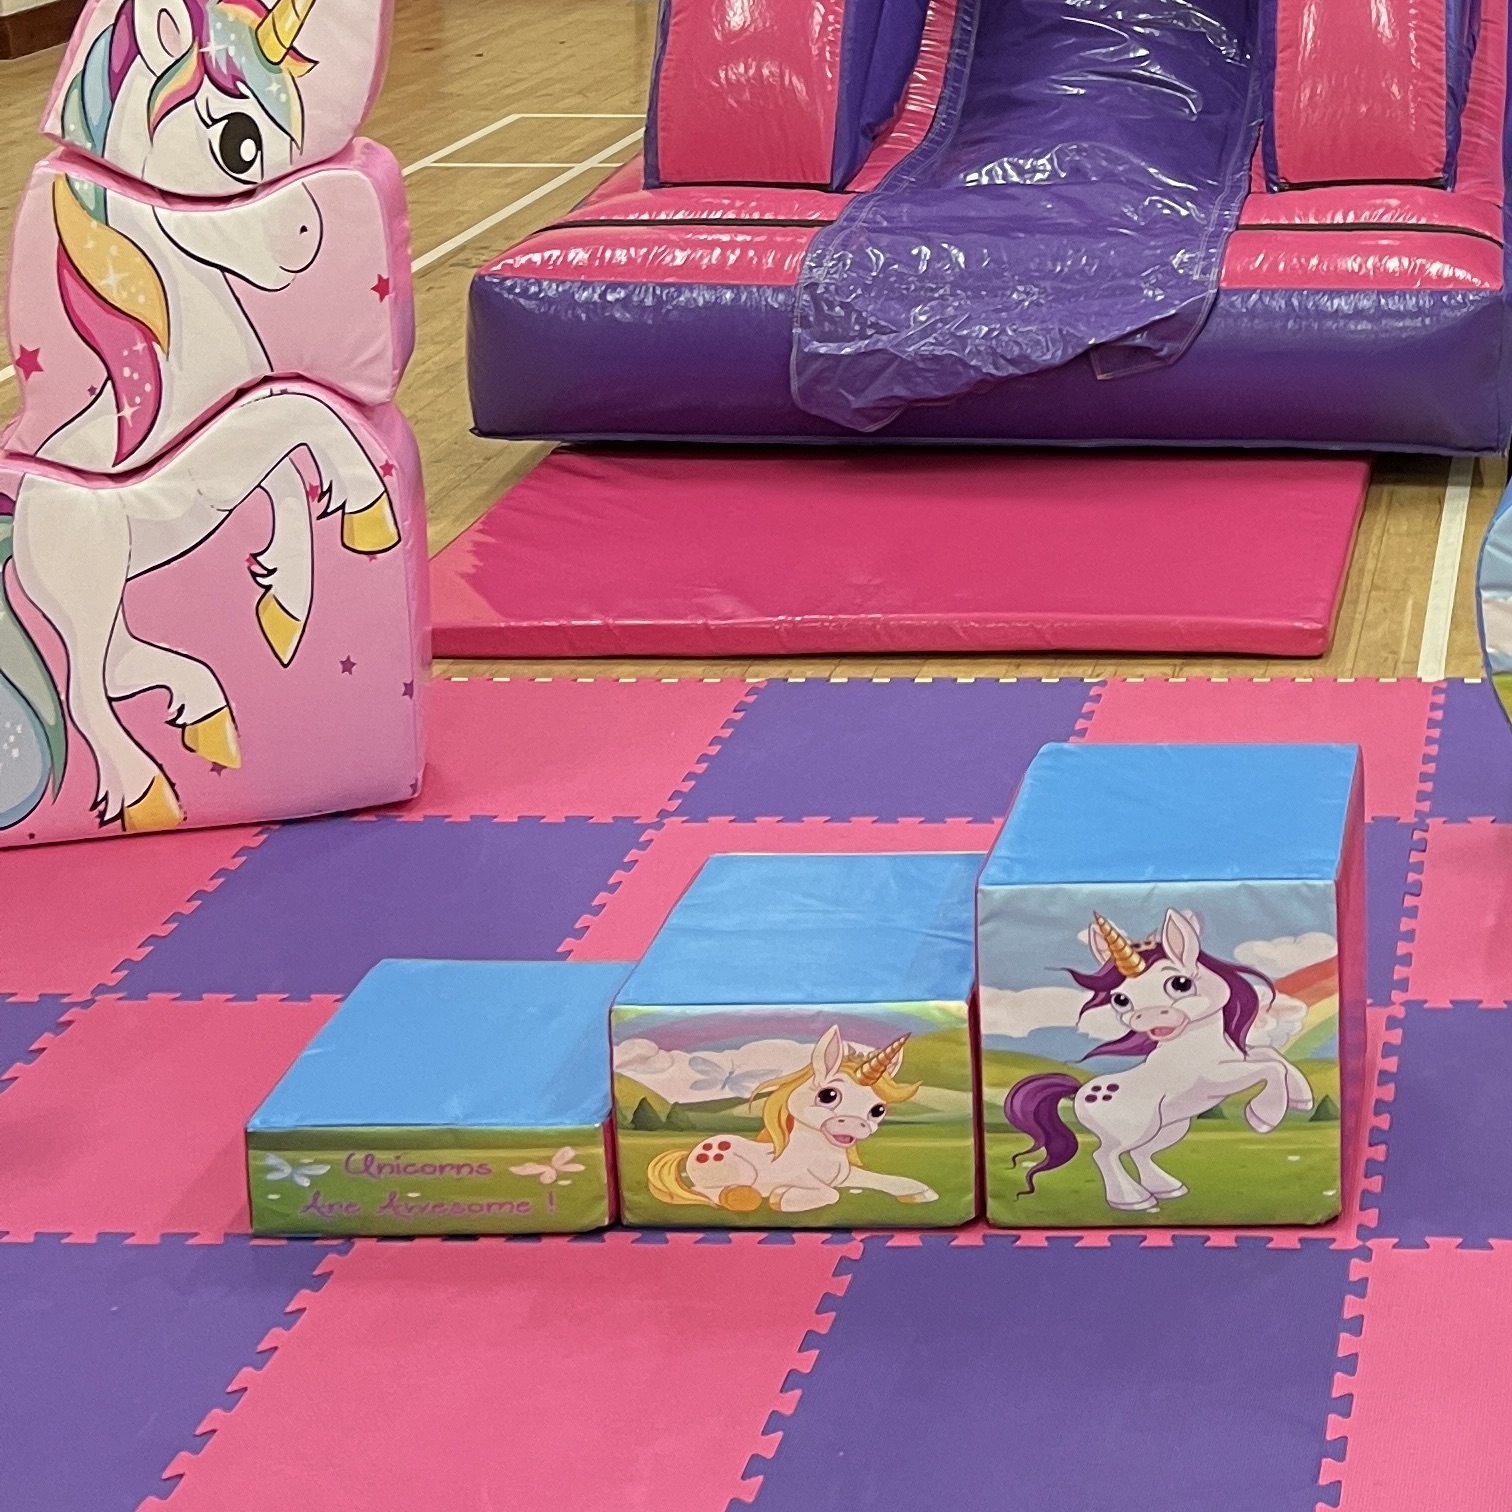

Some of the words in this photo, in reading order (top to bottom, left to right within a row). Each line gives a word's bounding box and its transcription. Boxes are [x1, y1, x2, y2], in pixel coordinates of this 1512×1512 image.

[344, 1152, 493, 1178] Unicorns
[302, 1190, 362, 1219] Are
[376, 1190, 534, 1221] Awesome
